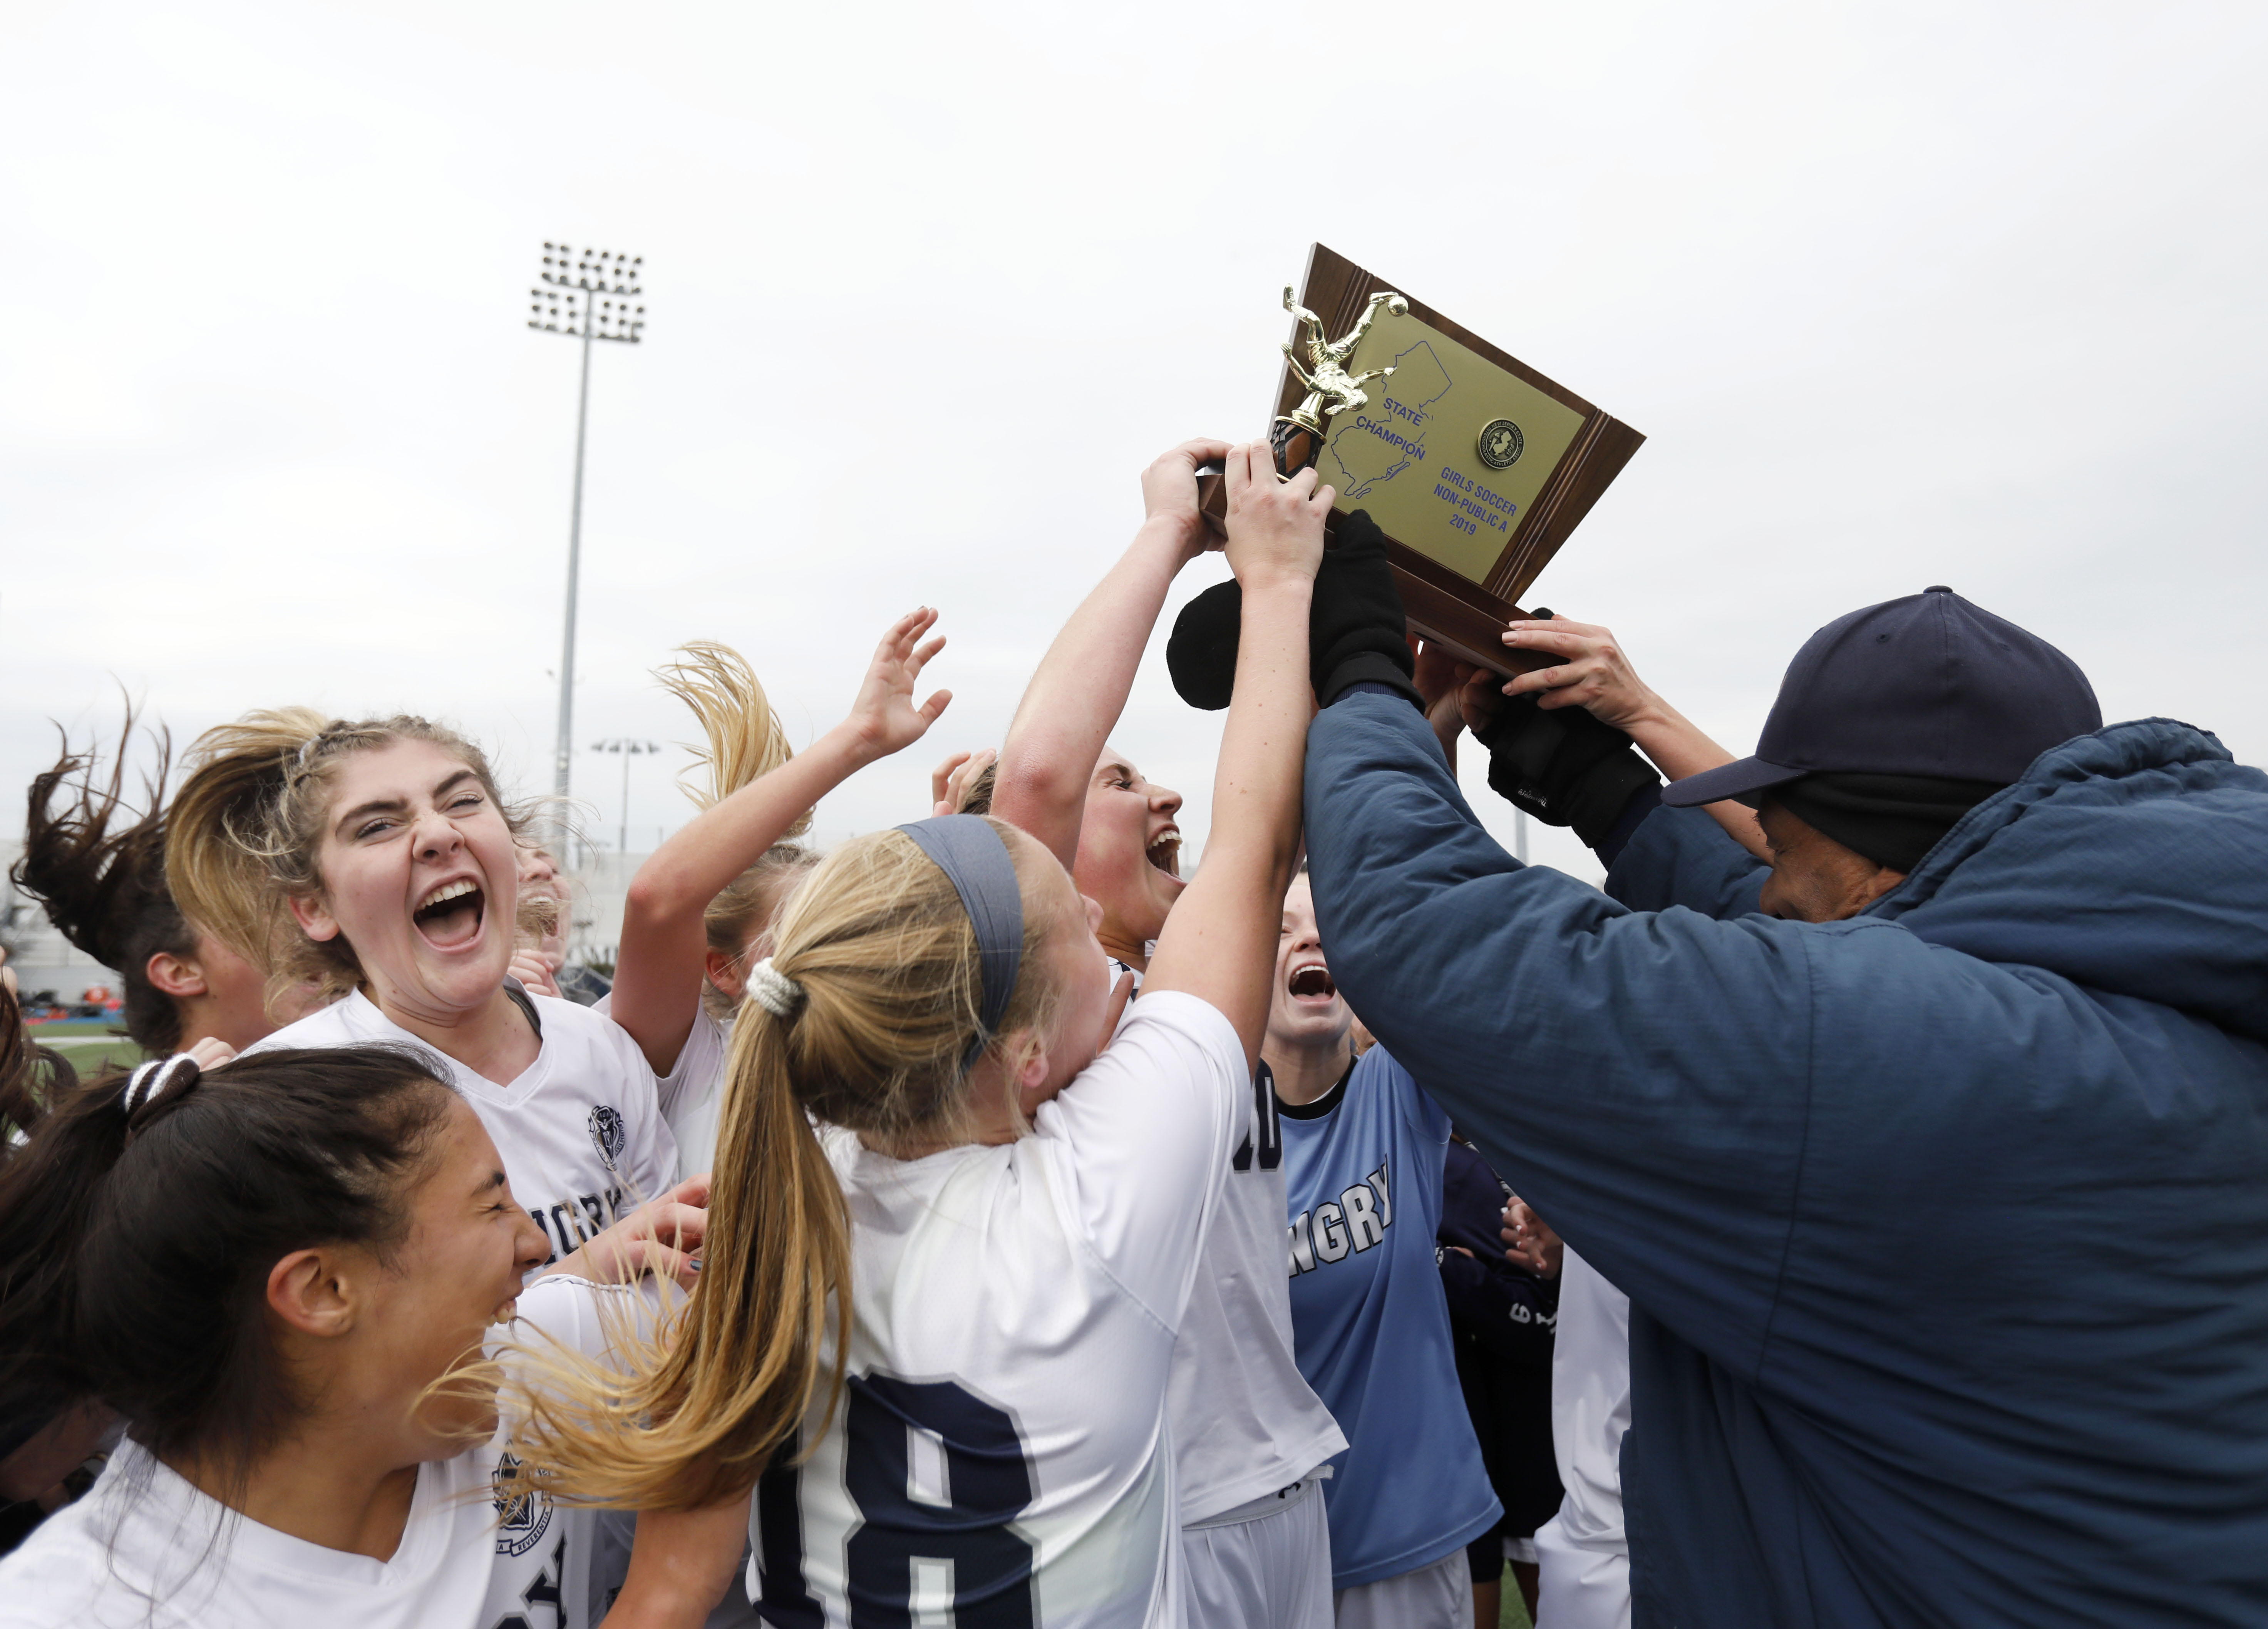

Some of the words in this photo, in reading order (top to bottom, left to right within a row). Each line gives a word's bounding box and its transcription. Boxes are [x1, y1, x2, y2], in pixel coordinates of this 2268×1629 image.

[1384, 398, 1423, 427] STATE
[1502, 422, 1517, 431] JERSEY
[1357, 416, 1425, 460] CHAMPION
[1506, 444, 1515, 455] 1918
[1434, 483, 1499, 526] NON-PUBLIC
[1498, 520, 1508, 532] A
[1441, 467, 1474, 492] GIRLS
[1474, 486, 1517, 517] SOCCER
[1449, 514, 1476, 535] 2019
[518, 1511, 550, 1552] REVERENTIA
